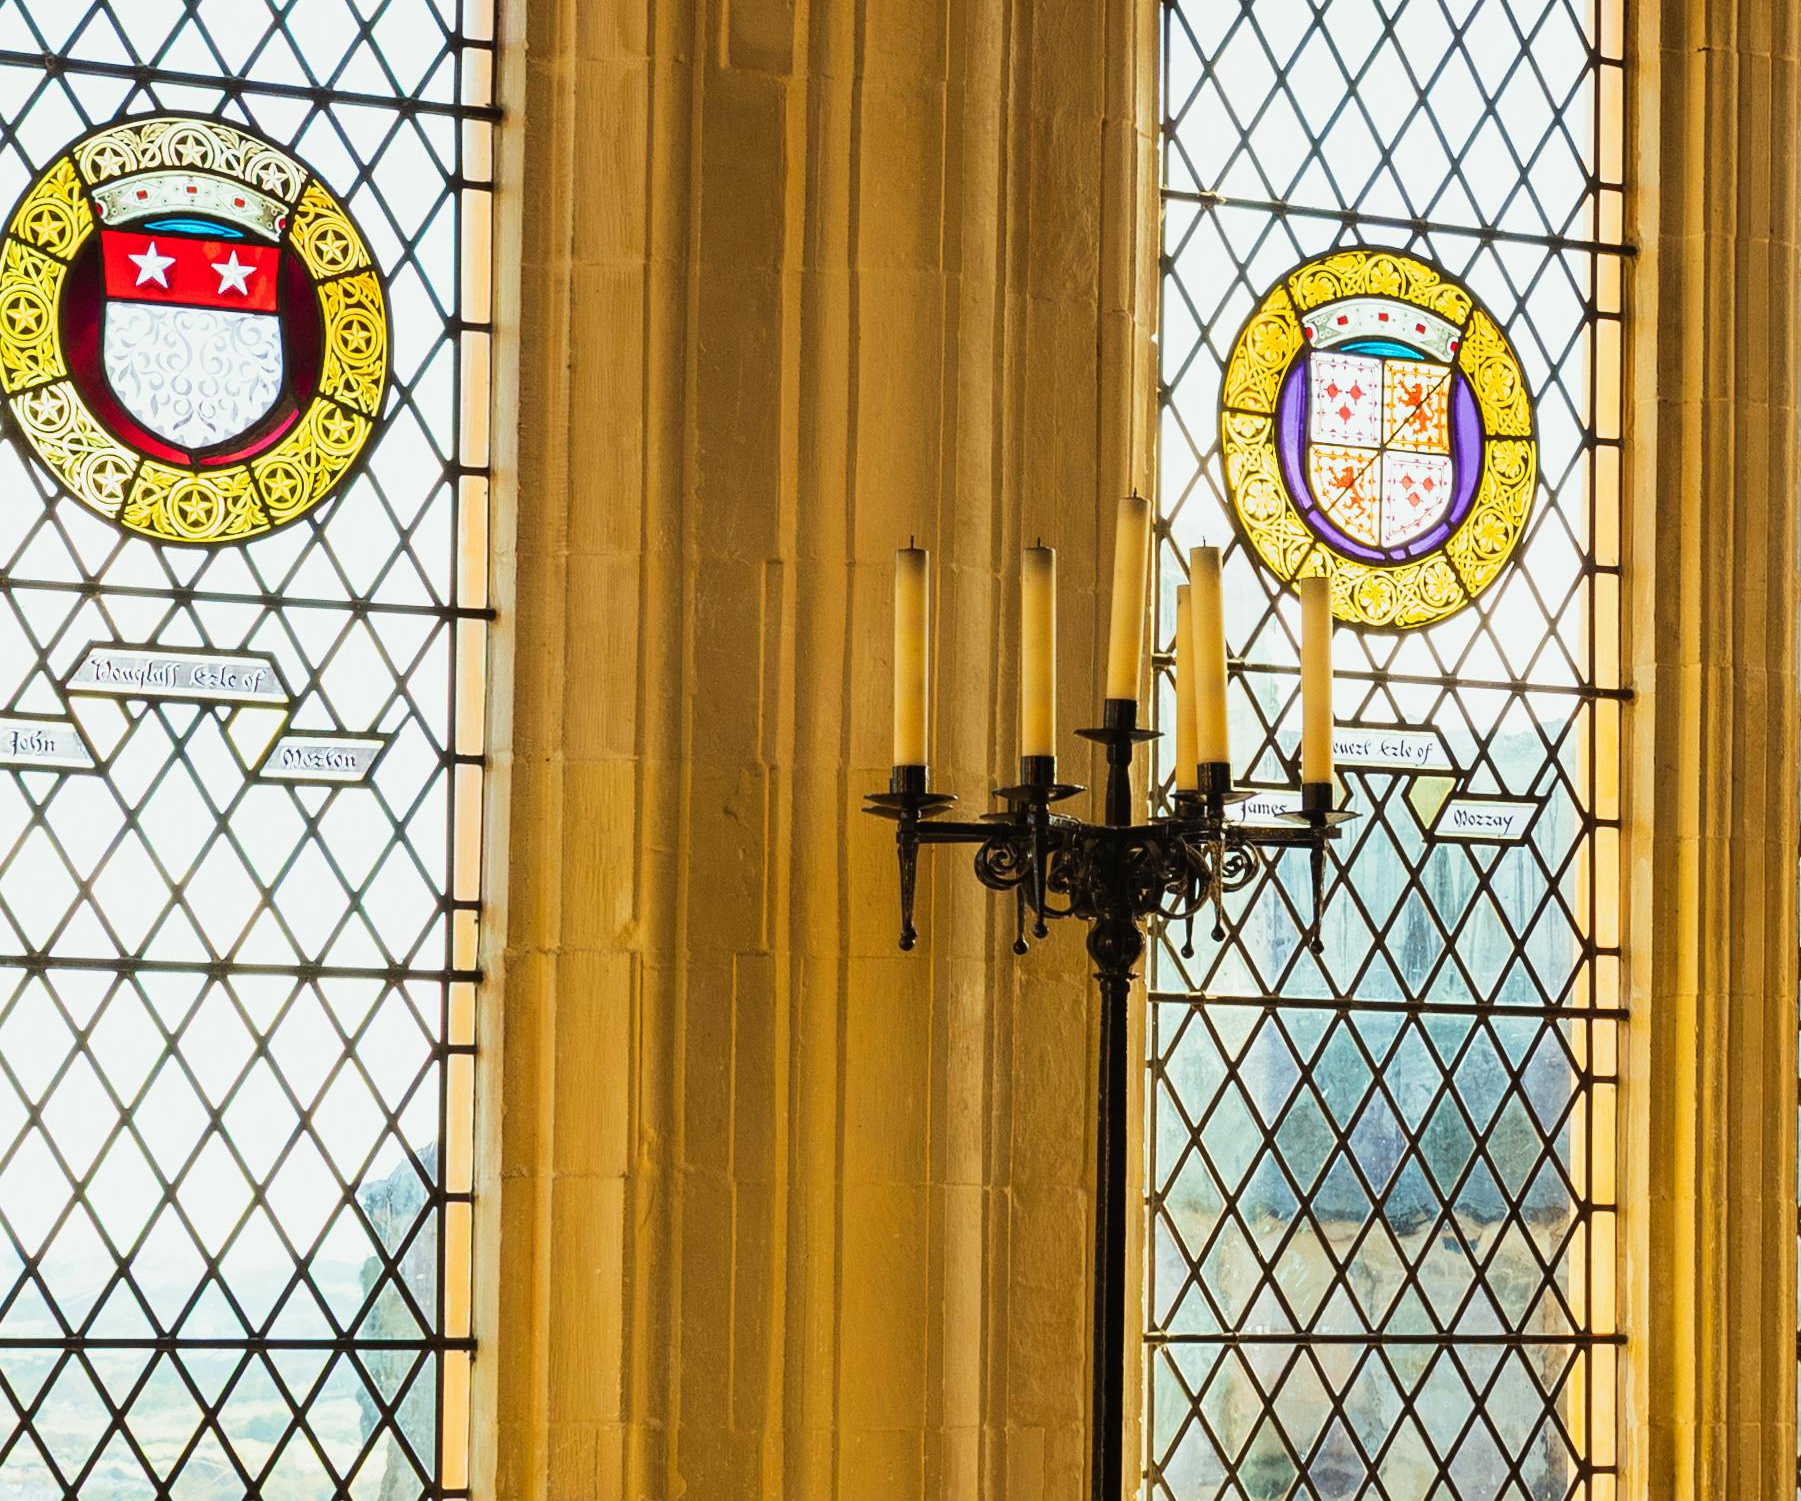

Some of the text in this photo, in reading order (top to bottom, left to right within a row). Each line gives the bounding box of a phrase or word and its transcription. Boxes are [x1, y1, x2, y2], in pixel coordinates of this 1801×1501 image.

[243, 671, 265, 693] of
[8, 730, 56, 756] John
[1417, 743, 1433, 765] of
[1240, 800, 1289, 822] James
